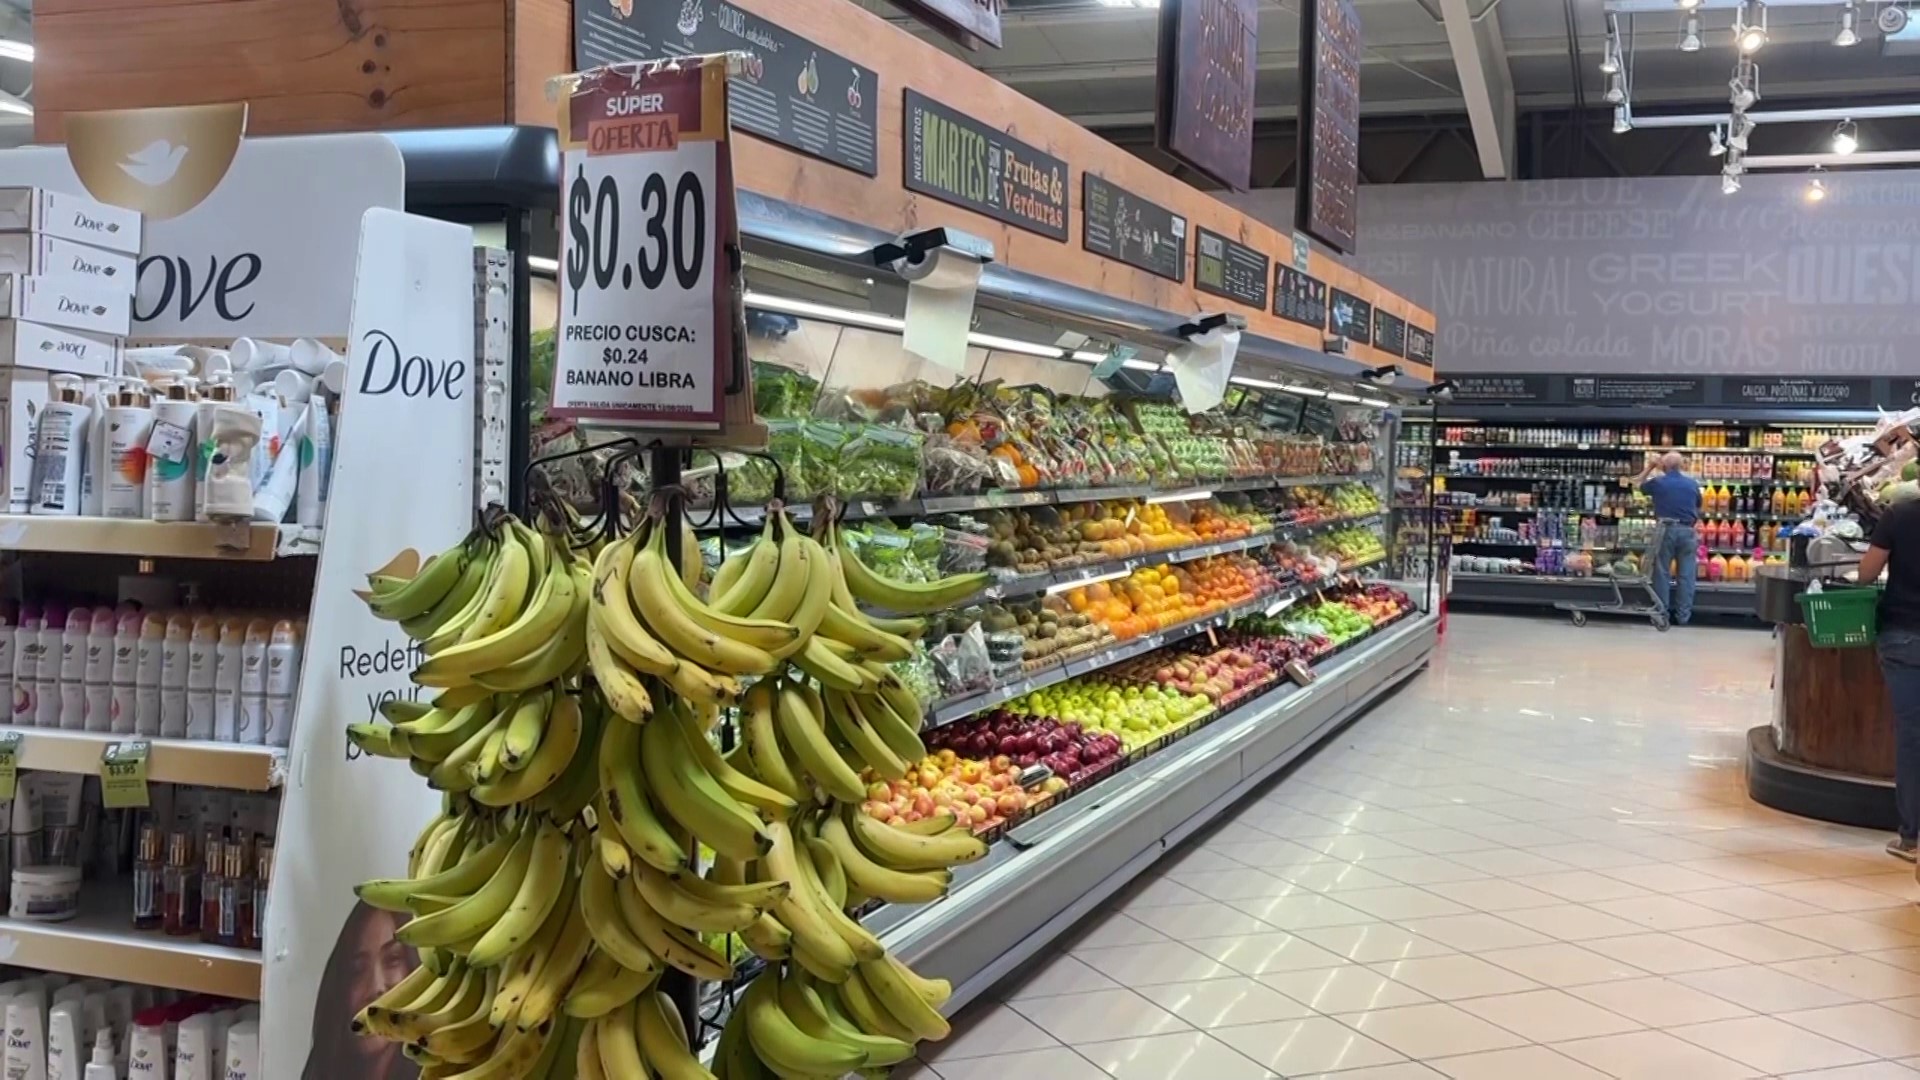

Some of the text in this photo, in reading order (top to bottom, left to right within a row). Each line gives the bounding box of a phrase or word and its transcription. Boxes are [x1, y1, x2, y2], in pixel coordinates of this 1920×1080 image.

[606, 91, 663, 116] SÚPER
[591, 122, 674, 153] OFERTA
[914, 107, 922, 181] NUESTROS
[923, 111, 985, 203] MARTES
[1003, 148, 1062, 205] Frutas &
[74, 211, 104, 232] Dove
[1003, 181, 1063, 230] Verduras
[567, 163, 705, 316] $0.30
[1527, 209, 1675, 240] CHEESE
[72, 255, 101, 276] Dove
[1588, 251, 1782, 284] GREEK
[1787, 244, 1920, 304] QUES
[133, 252, 262, 323] ove
[1432, 255, 1577, 317] NATURAL
[58, 296, 90, 316] Dove
[1593, 290, 1783, 317] YOGURT
[566, 325, 696, 343] PRECIO CUSCA:
[1443, 321, 1520, 357] Piña
[1528, 321, 1636, 357] colada
[1651, 324, 1781, 367] MORAS
[359, 329, 465, 400] Dove
[602, 347, 648, 366] $0.24
[1801, 343, 1898, 371] RICOTTA
[566, 370, 695, 389] BANANO LIBRA
[340, 637, 425, 679] Redefi
